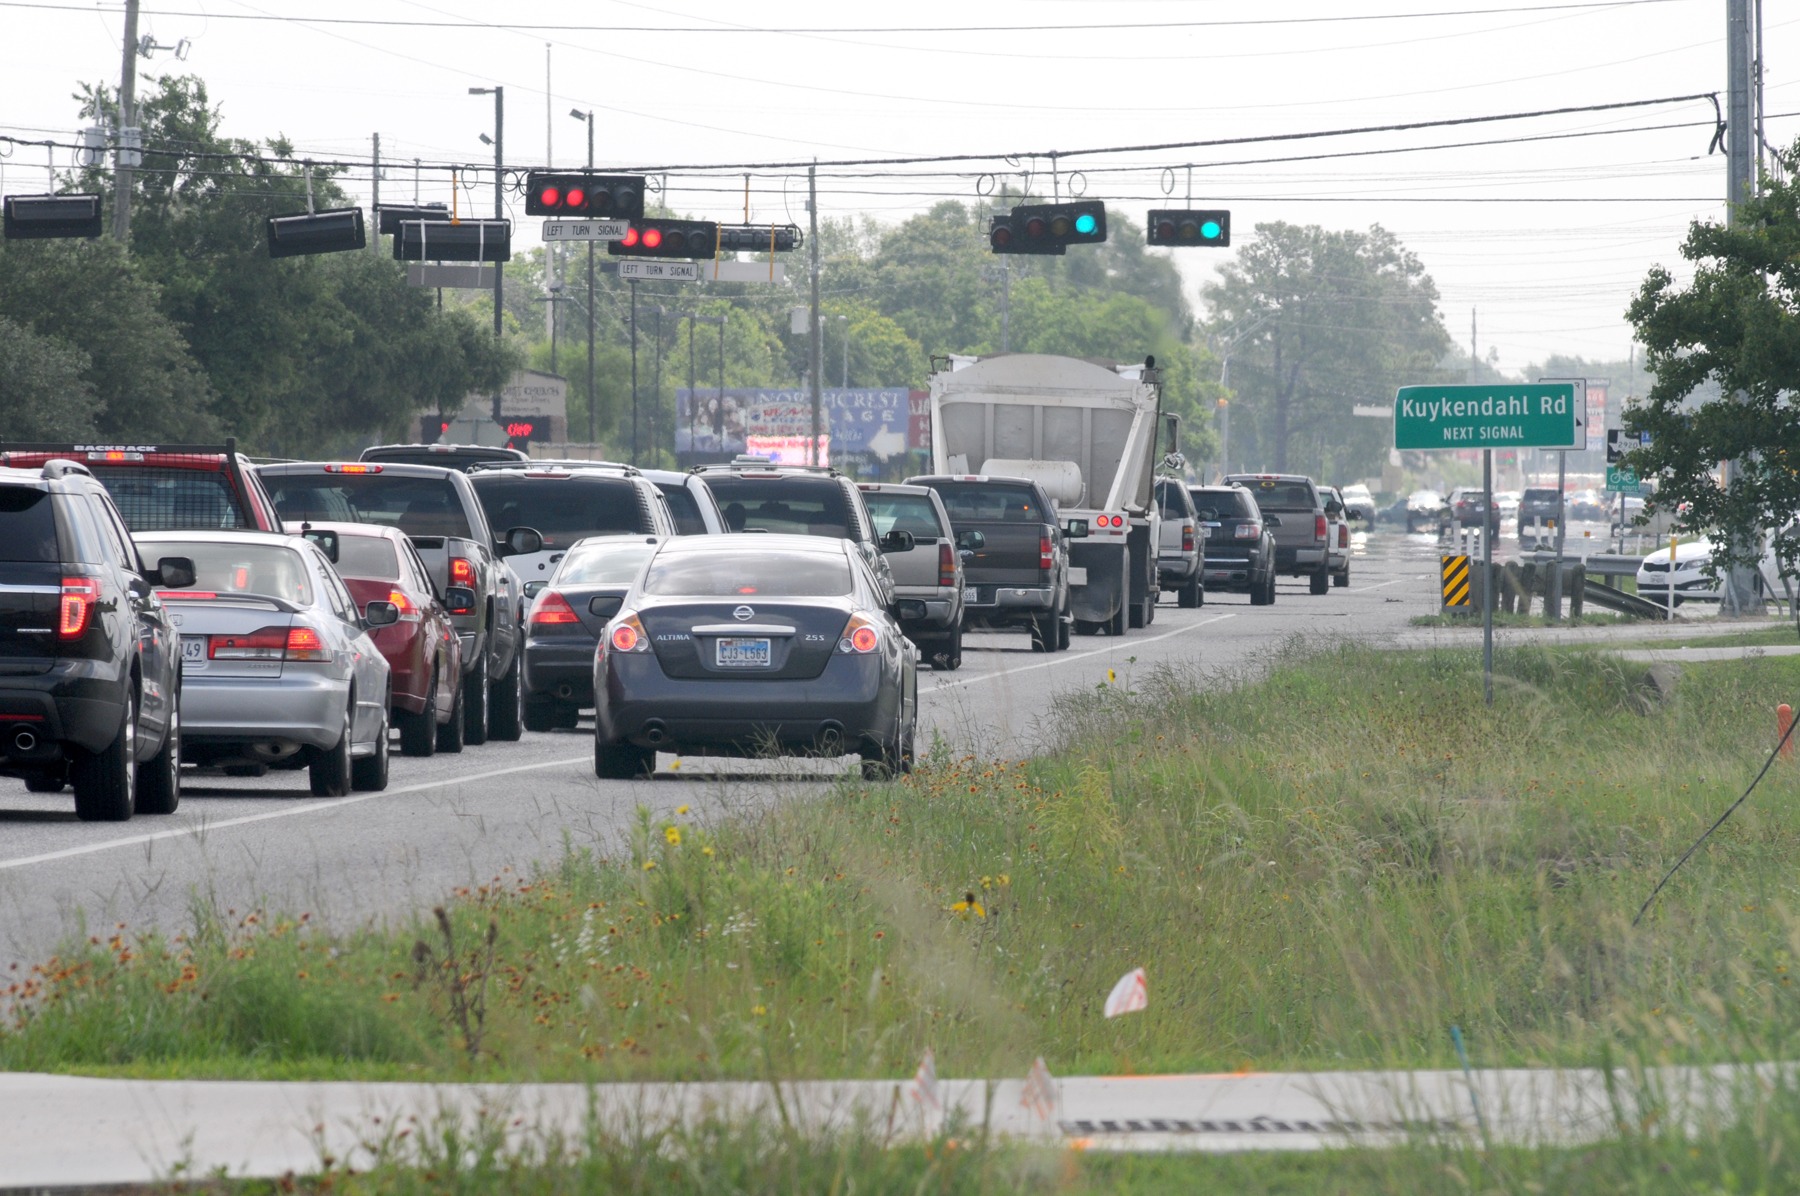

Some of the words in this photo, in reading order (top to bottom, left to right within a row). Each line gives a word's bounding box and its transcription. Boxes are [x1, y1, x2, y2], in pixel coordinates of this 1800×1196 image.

[546, 225, 563, 236] LEFT
[572, 225, 590, 236] TURN
[597, 225, 624, 236] SIGNAL
[622, 264, 638, 274] LEFT
[646, 265, 663, 275] TURN
[670, 266, 693, 277] SIGNAL
[760, 391, 900, 408] NORHCREST
[1402, 395, 1529, 422] Kuykendahl
[1540, 394, 1567, 415] Rd
[1443, 427, 1474, 440] NEXT
[1479, 425, 1524, 440] SIGNAL
[1618, 441, 1639, 449] 2920
